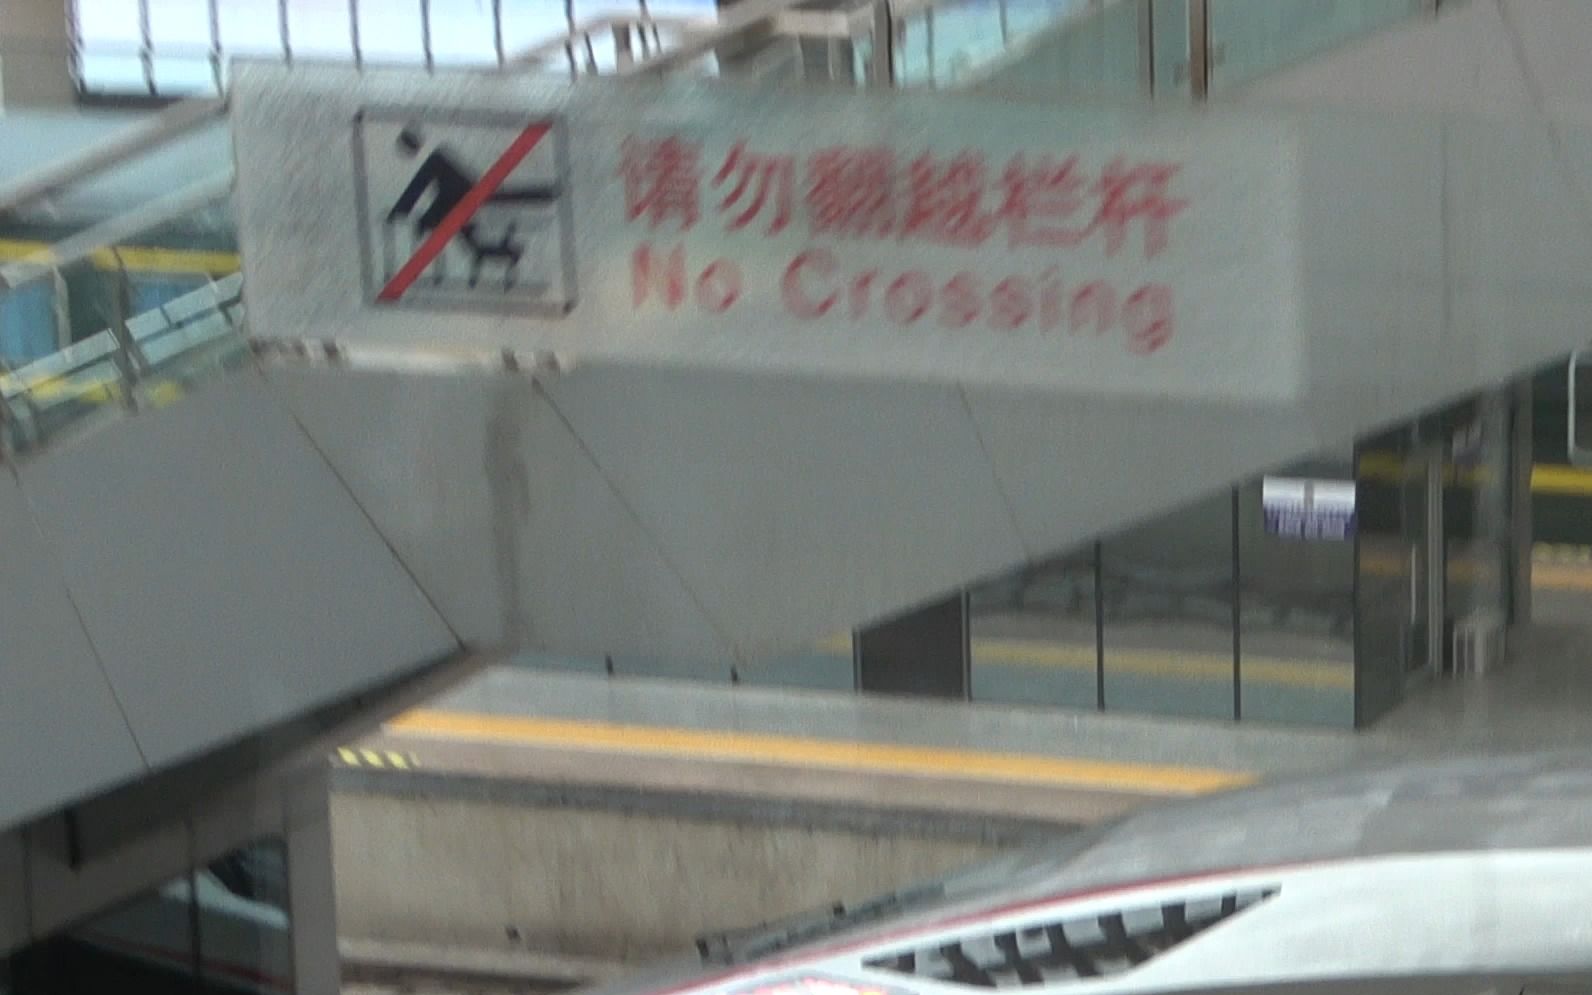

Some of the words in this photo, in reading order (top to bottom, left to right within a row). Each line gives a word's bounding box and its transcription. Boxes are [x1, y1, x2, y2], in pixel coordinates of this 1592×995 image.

[617, 134, 1189, 257] 请勿翻越栏杆
[631, 242, 740, 313] No
[781, 248, 1175, 354] Crossing
